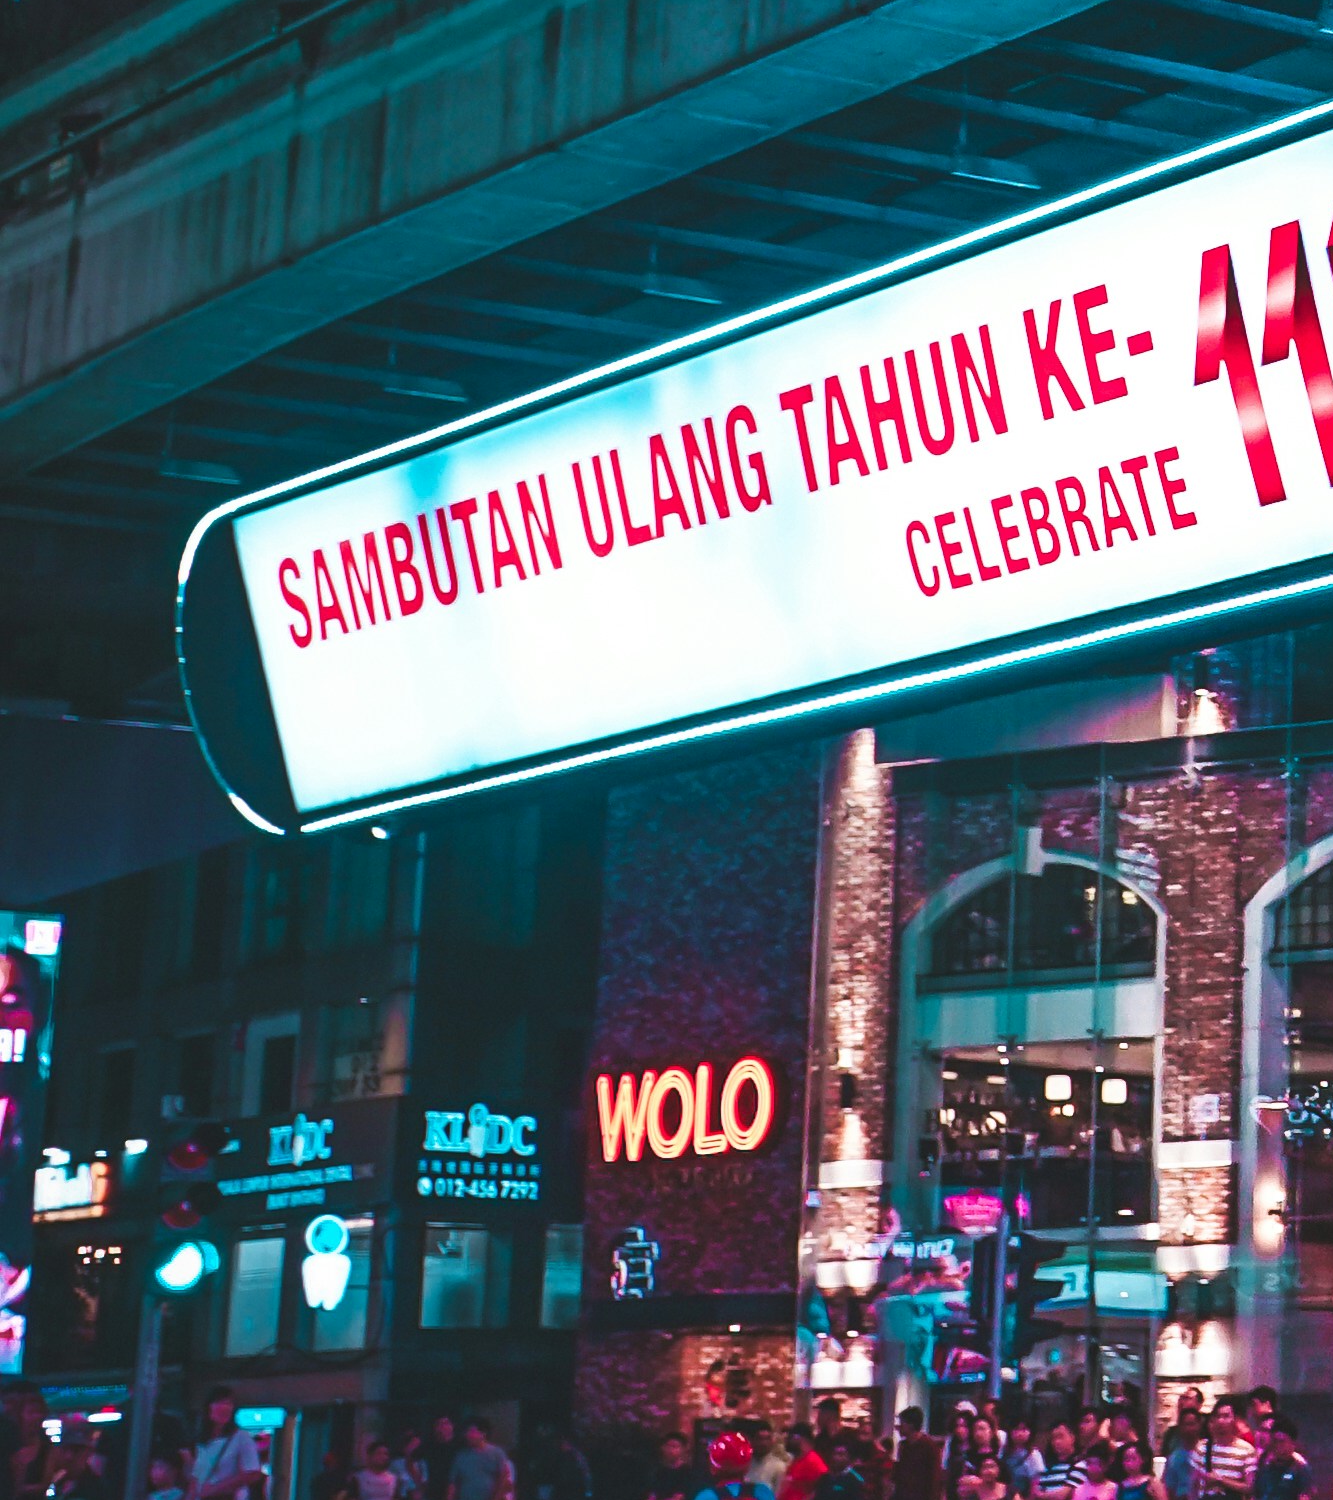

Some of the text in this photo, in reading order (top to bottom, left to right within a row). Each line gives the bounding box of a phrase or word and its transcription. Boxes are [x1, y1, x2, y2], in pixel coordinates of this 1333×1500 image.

[279, 475, 562, 648] SAMBUTAN
[572, 406, 771, 557] ULANG
[779, 325, 1008, 491] TAHUN
[1023, 285, 1153, 419] KE-
[906, 447, 1197, 596] CELEBRATE
[597, 1056, 774, 1162] WOLO
